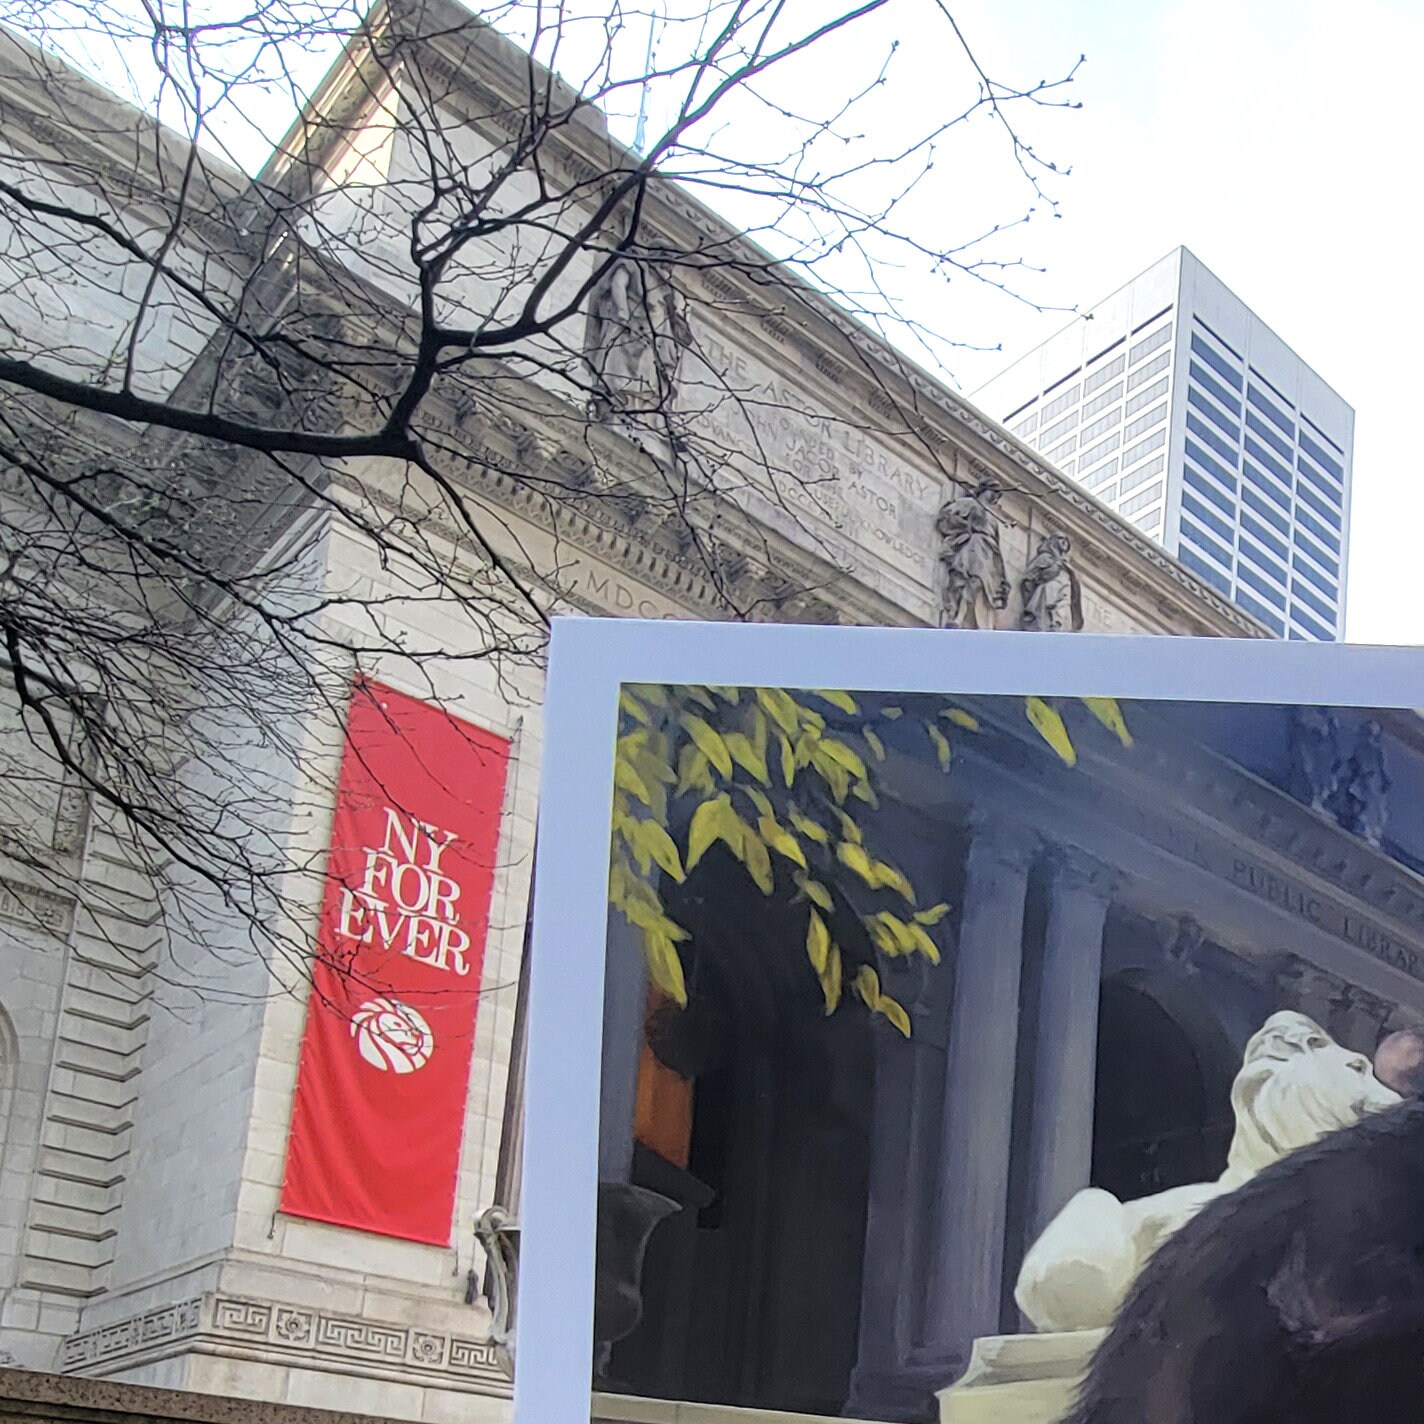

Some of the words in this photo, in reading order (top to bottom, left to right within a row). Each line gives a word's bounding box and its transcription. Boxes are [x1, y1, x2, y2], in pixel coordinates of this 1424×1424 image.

[705, 341, 748, 380] THE
[762, 380, 832, 439] ASTOR
[842, 430, 930, 499] LIBRARY
[847, 478, 897, 520] ASTOR
[587, 569, 677, 619] MDC
[378, 806, 459, 874] NY
[357, 847, 461, 925] FOR
[334, 887, 470, 976] EVER
